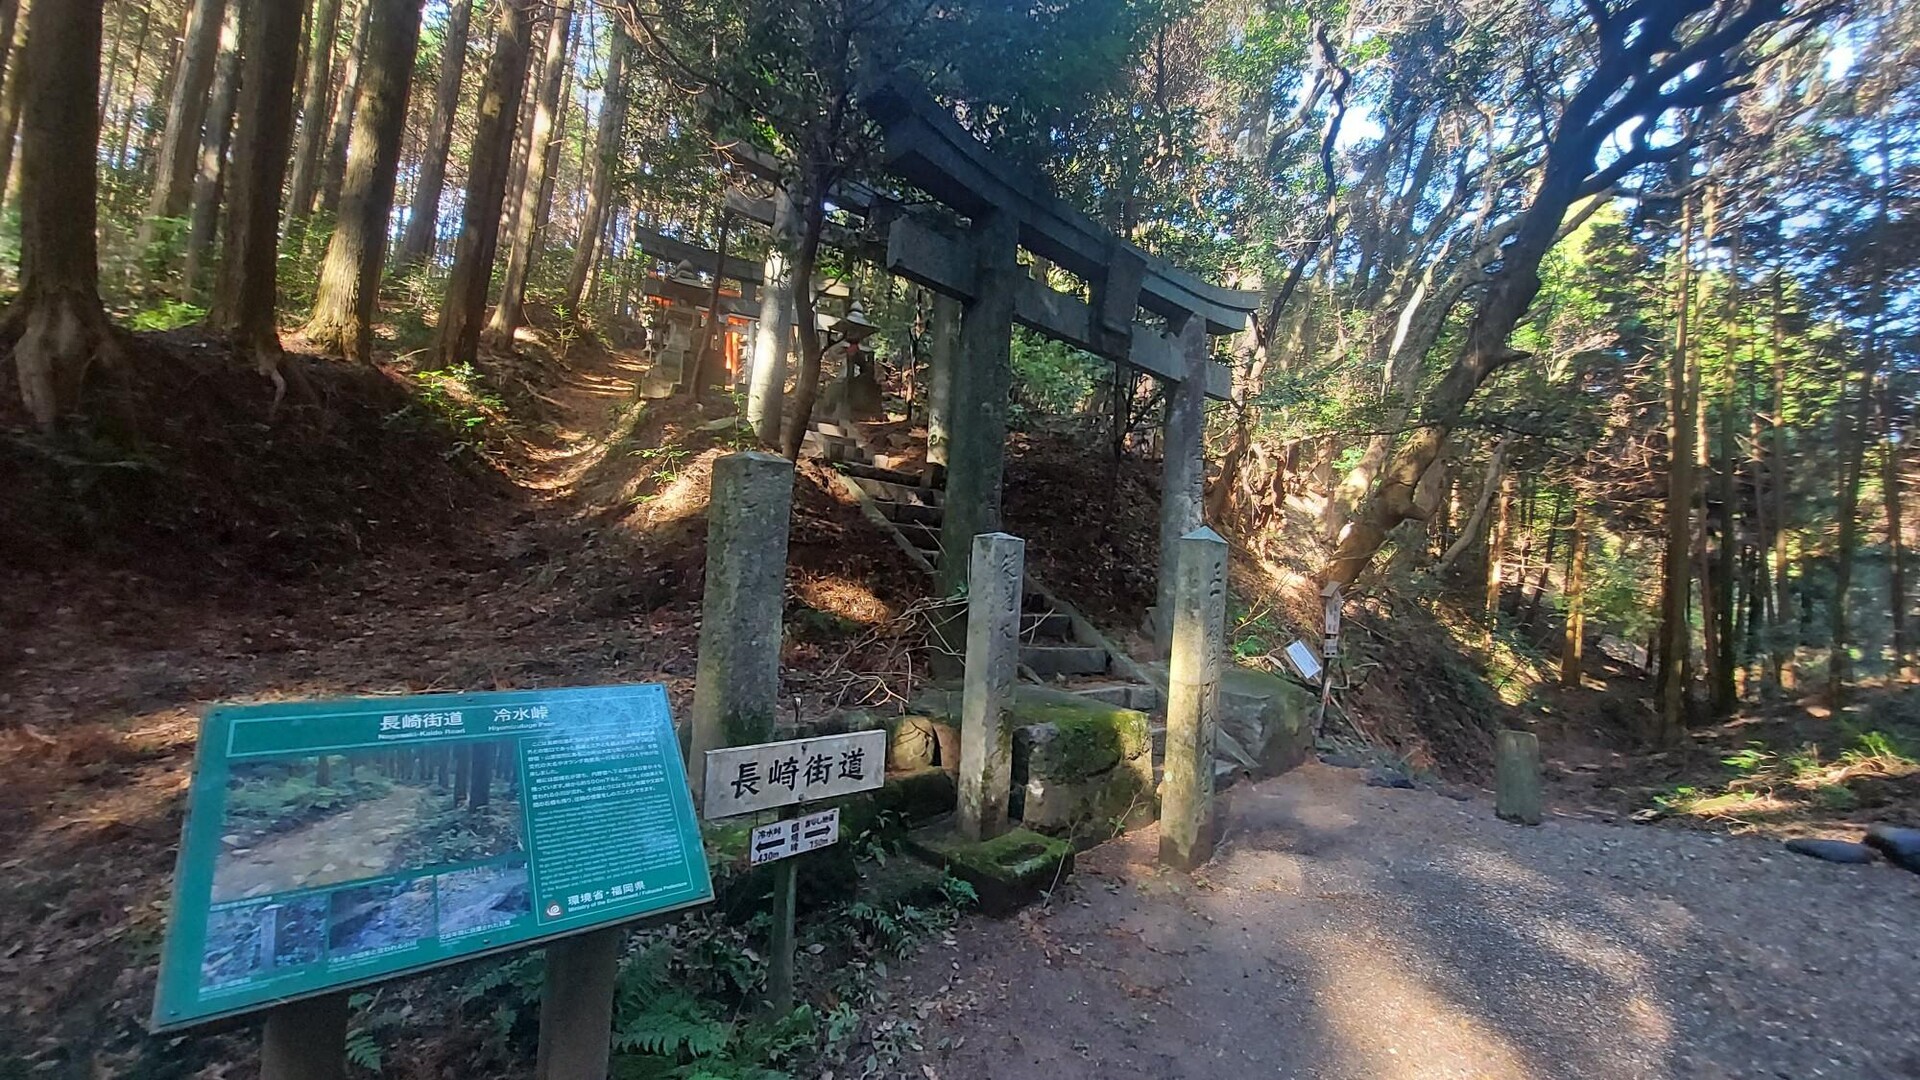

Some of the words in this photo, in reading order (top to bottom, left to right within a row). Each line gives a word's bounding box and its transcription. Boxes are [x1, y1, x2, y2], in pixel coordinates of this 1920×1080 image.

[379, 711, 464, 732] 長崎街道
[492, 705, 550, 723] 冷水峠
[730, 747, 866, 800] 長崎街道
[757, 851, 780, 863] 430m
[567, 880, 646, 906] 環境省・福岡県
